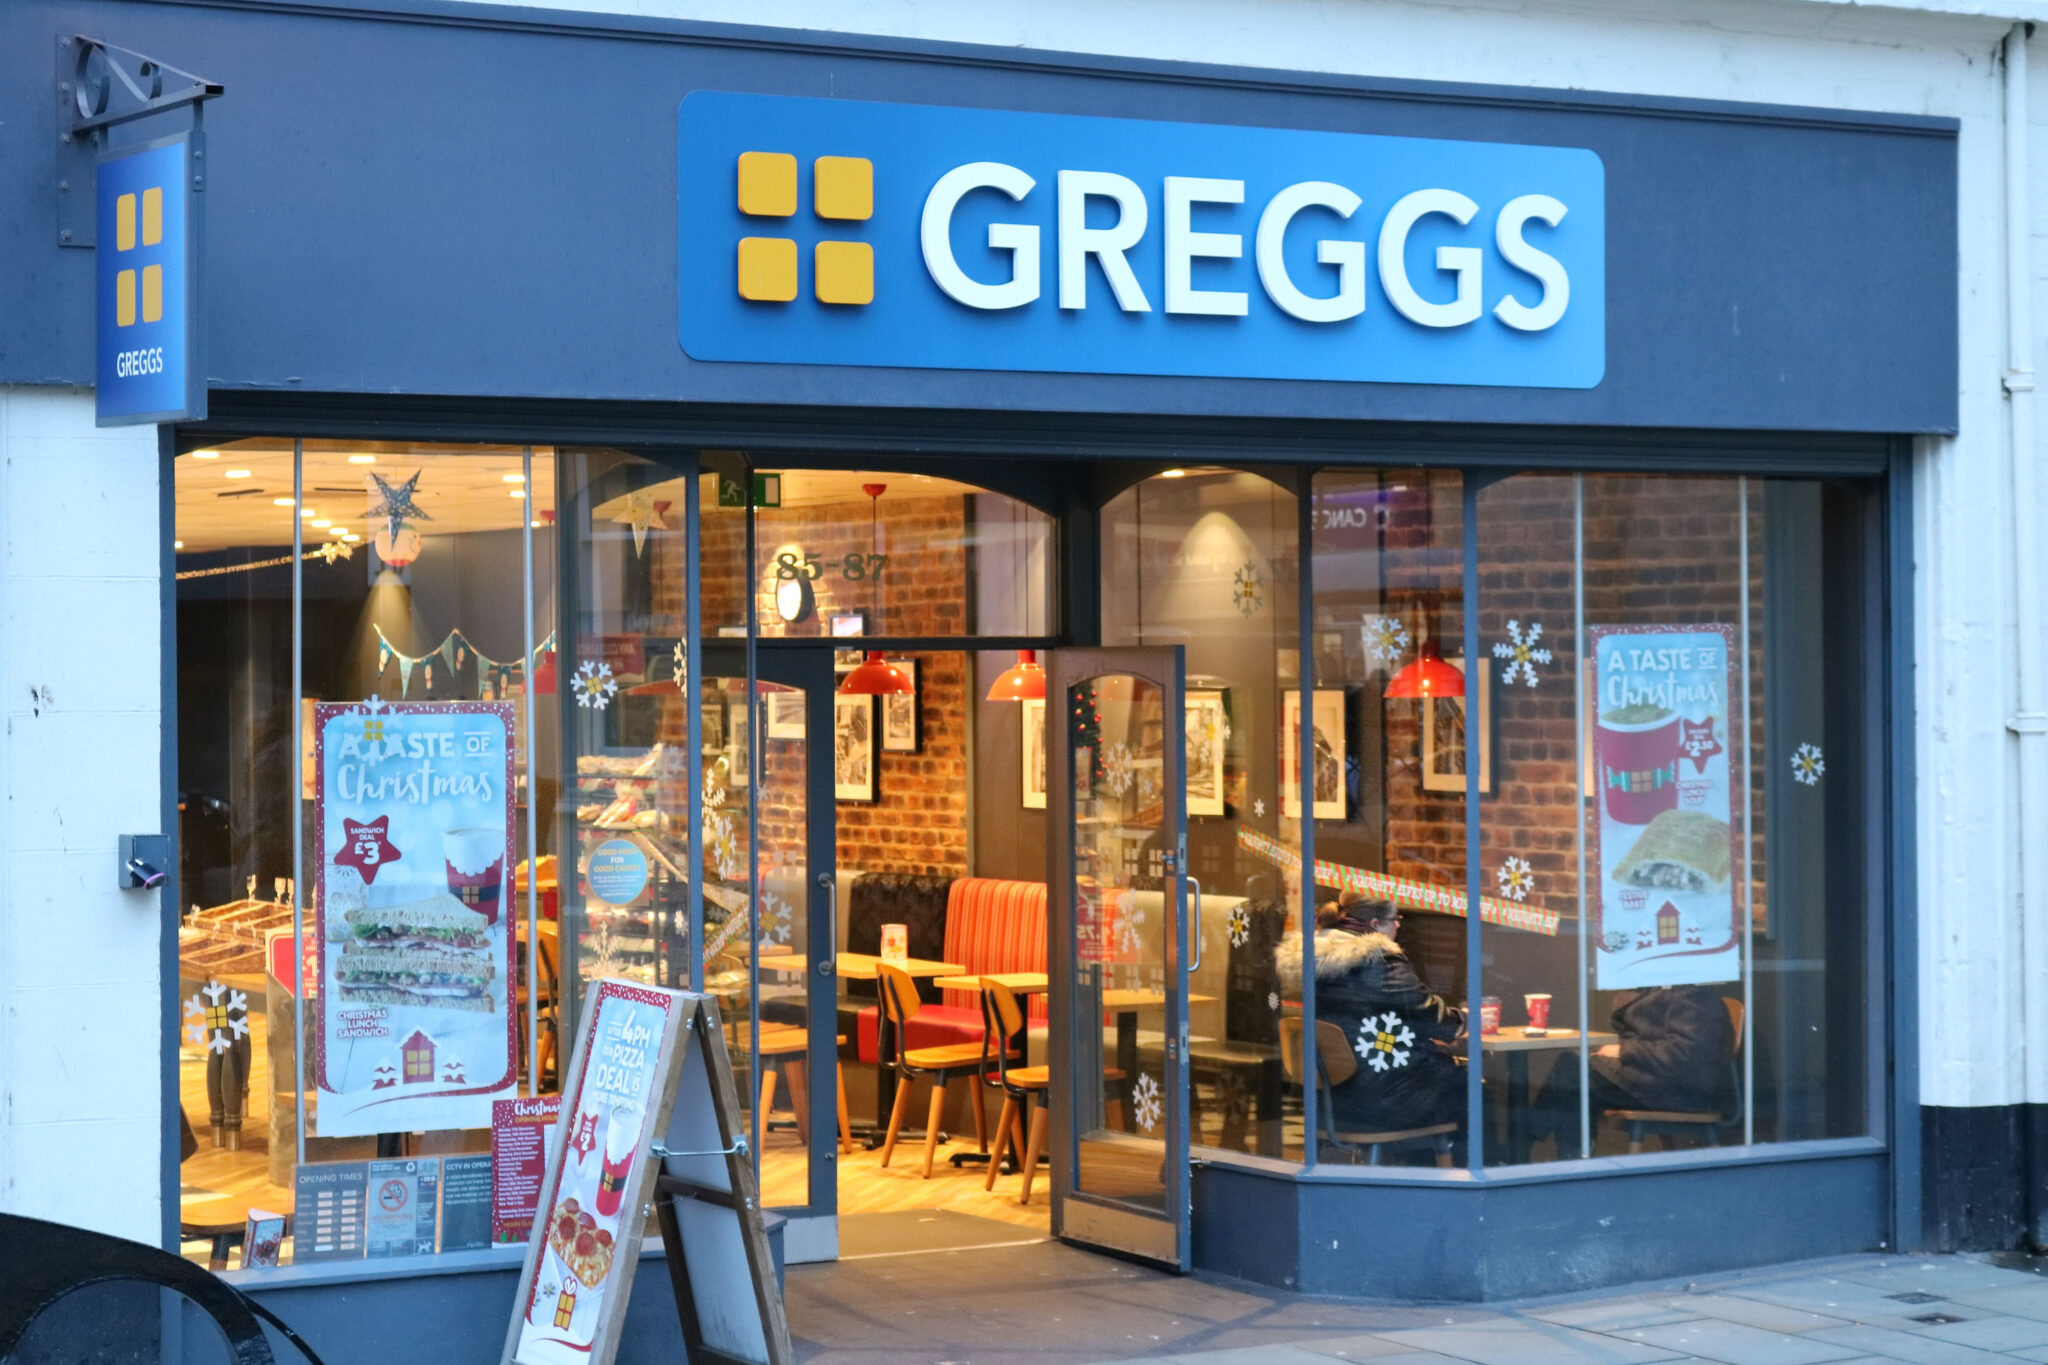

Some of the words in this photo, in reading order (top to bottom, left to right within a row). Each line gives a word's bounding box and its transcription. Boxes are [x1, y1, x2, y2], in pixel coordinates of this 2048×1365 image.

[920, 160, 1570, 331] GREGGS
[117, 347, 163, 378] GREGGS
[776, 553, 888, 581] 85-87
[1608, 651, 1625, 672] A
[1629, 648, 1692, 672] TASTE
[1701, 652, 1716, 665] OF
[1608, 671, 1718, 709] Christmas
[466, 737, 491, 753] OF
[337, 758, 493, 805] Christmas
[350, 827, 385, 835] SANDWICH
[610, 856, 624, 864] FOR
[1352, 874, 1396, 894] NAUGHTY
[1396, 884, 1424, 900] ELVES
[1424, 889, 1437, 903] UP
[1438, 892, 1451, 906] TO
[338, 1009, 387, 1020] CHRISTMAS
[348, 1019, 378, 1029] LUNCH
[338, 1028, 388, 1039] SANDWICH
[611, 1044, 645, 1070] PIZZA
[595, 1063, 630, 1095] DEAL
[580, 1131, 591, 1151] £2
[446, 1162, 462, 1170] CCTV
[298, 1174, 337, 1184] OPENING
[339, 1172, 363, 1182] TIMES
